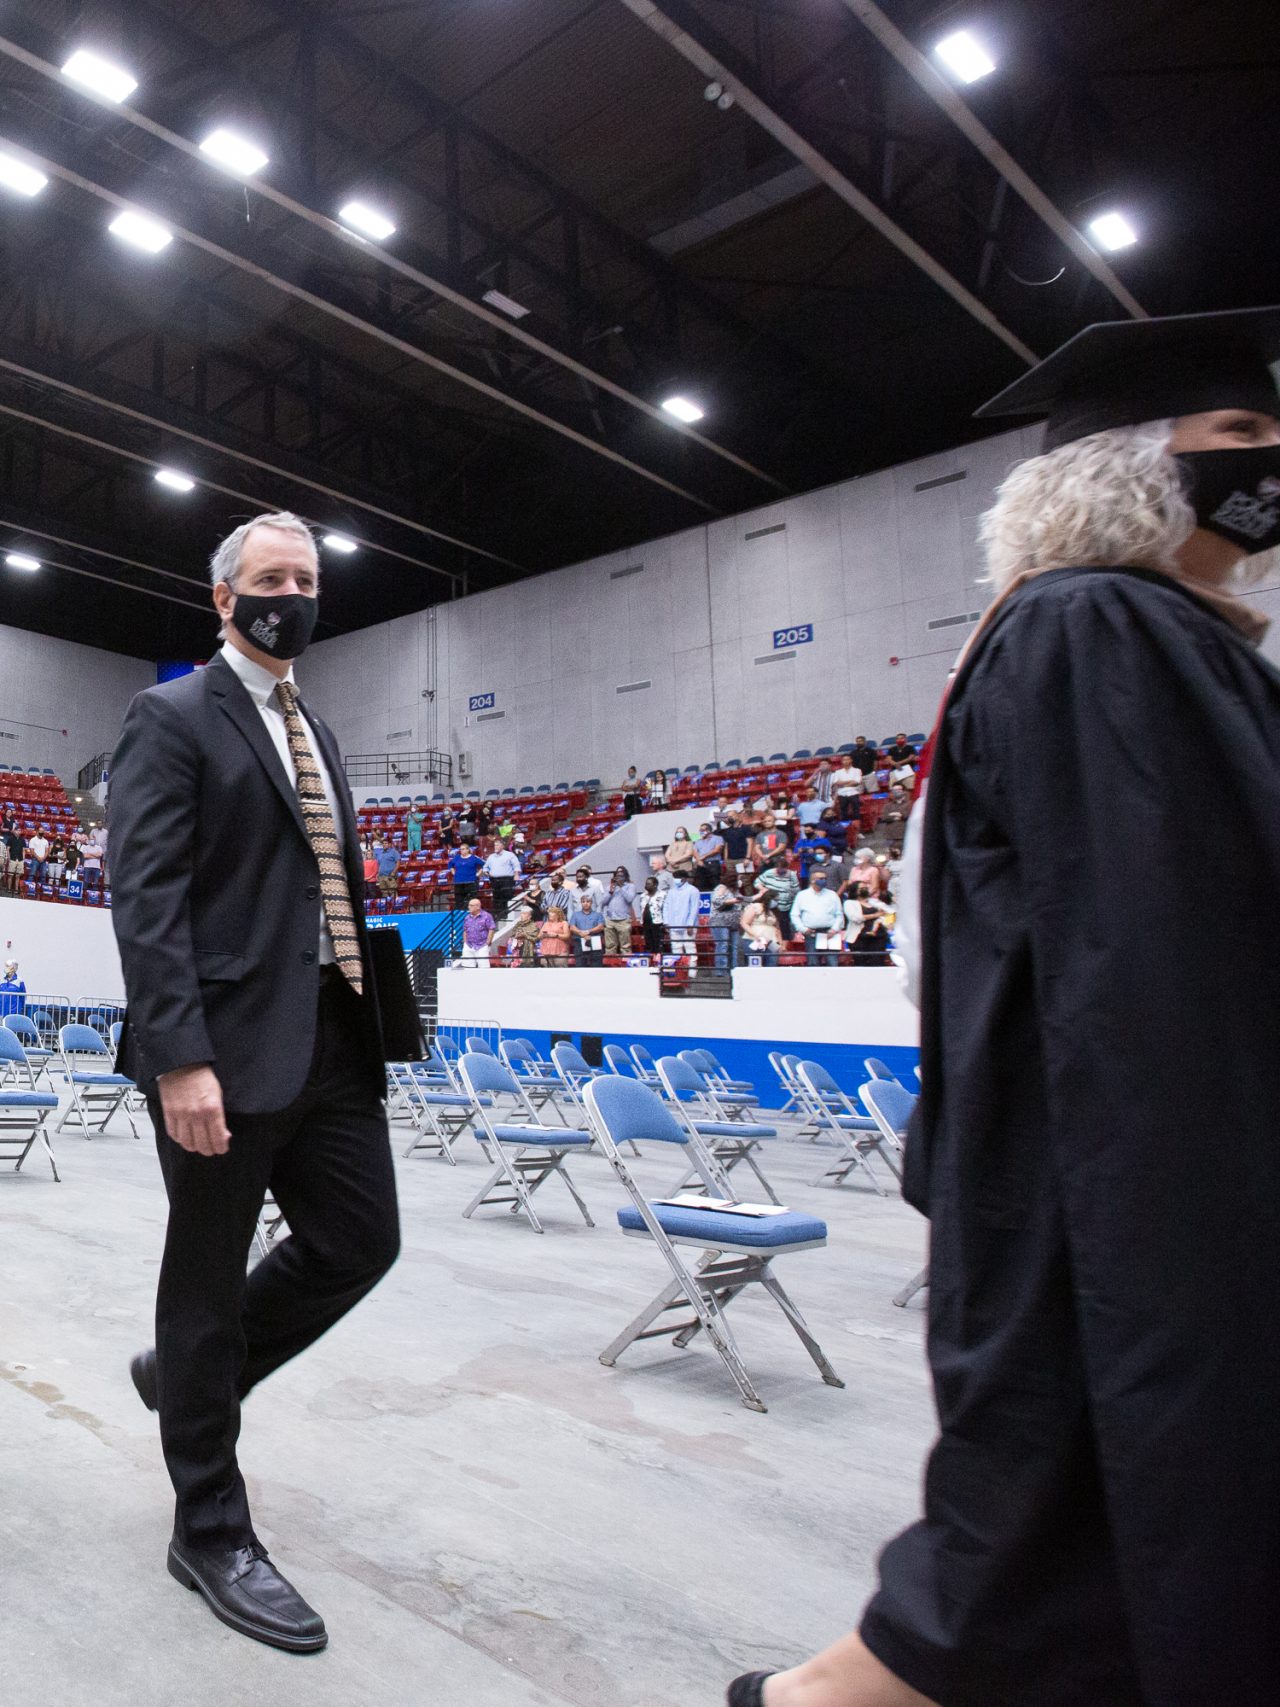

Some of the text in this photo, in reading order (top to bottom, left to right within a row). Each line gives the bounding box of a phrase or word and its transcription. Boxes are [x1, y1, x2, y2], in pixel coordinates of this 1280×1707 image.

[776, 627, 809, 646] 205
[471, 695, 492, 709] 204
[69, 885, 80, 894] 34
